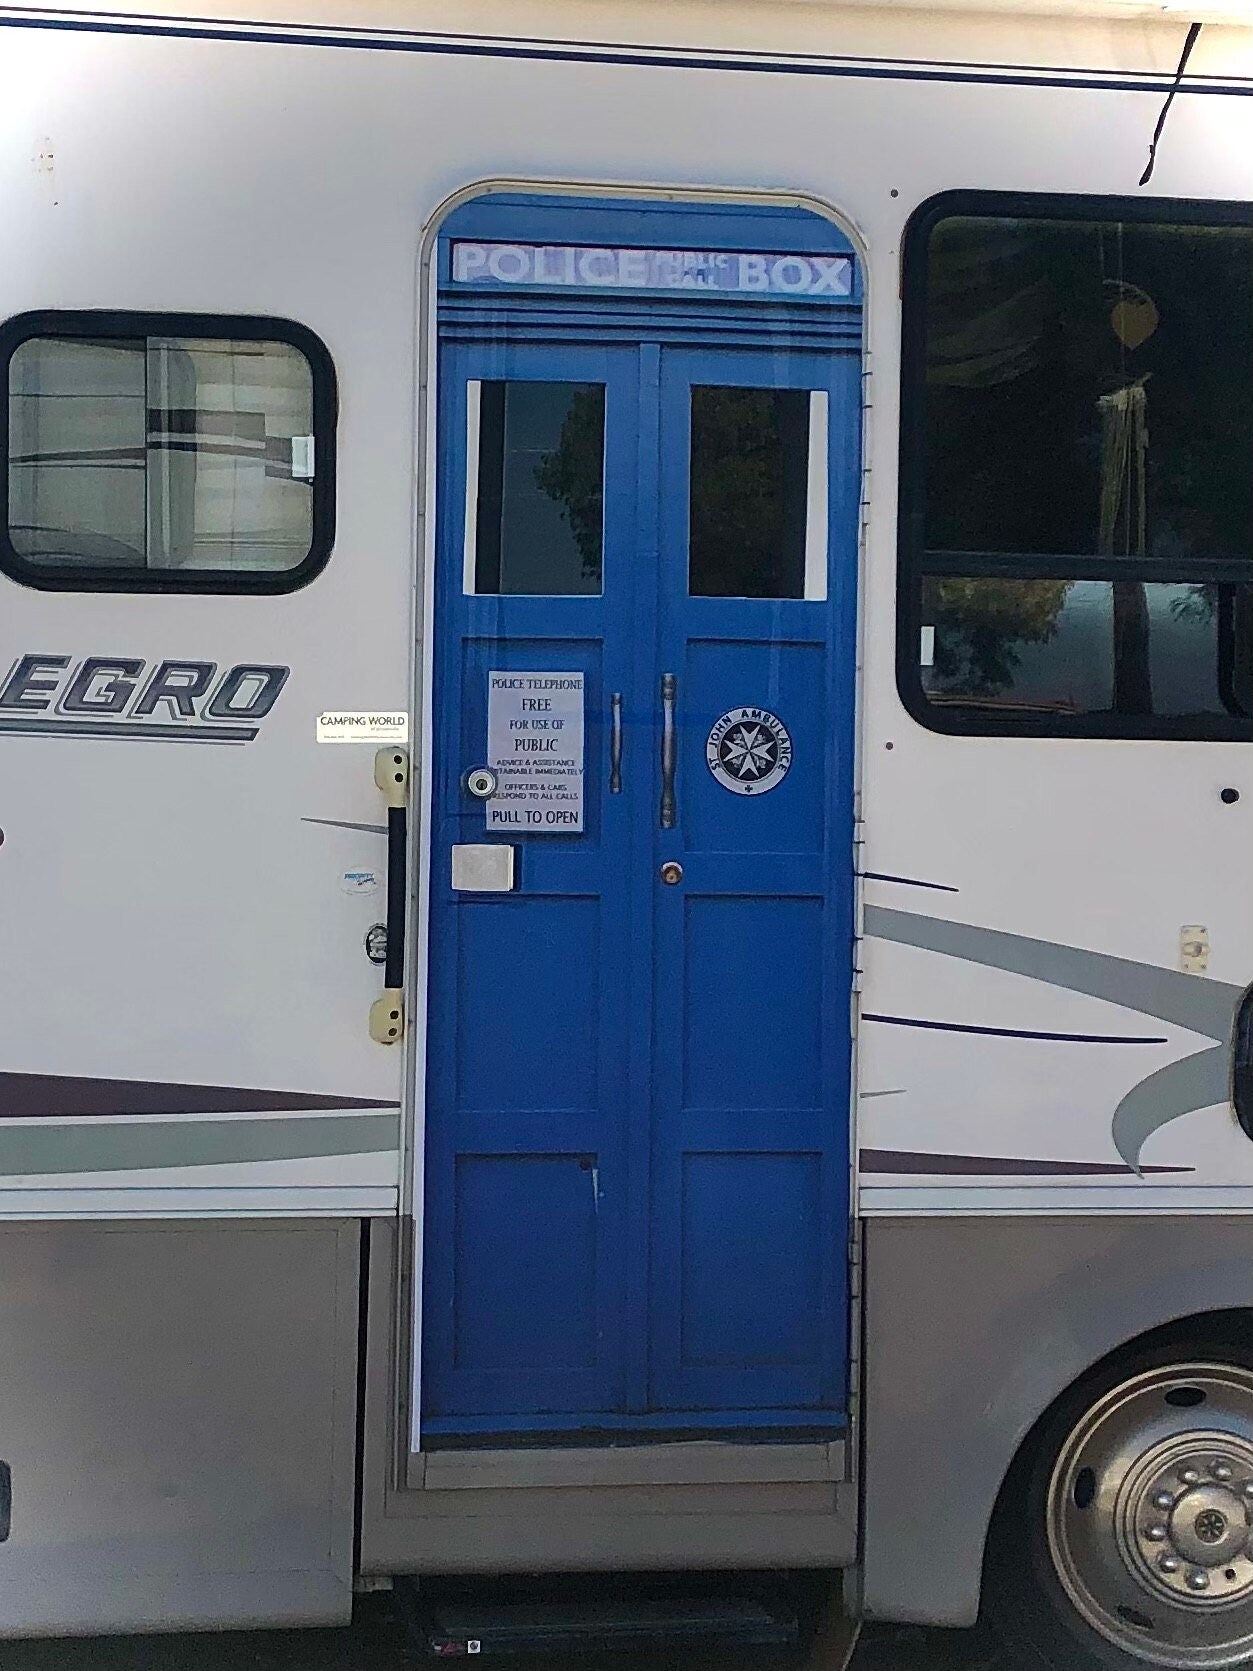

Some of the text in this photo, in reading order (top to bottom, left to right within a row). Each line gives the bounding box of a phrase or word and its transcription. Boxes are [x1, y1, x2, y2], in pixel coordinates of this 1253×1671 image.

[453, 242, 648, 287] POLICE
[738, 254, 850, 295] BOX
[492, 678, 583, 690] POLICE TELEPHONE
[522, 698, 552, 711] FREE
[320, 716, 405, 726] CAMPING WORLD
[509, 719, 566, 730] FOR USE OF
[514, 738, 559, 752] PUBLIC
[709, 709, 791, 773] ST JOHN AMBULANCE
[496, 759, 522, 767] ADVICE
[532, 759, 576, 767] ASSISTANCE
[534, 768, 585, 776] IMMEDIATELY
[504, 783, 568, 792] OFFICERS & CARS
[529, 792, 539, 800] TO
[540, 792, 554, 800] ALL
[492, 810, 579, 824] PULL TO OPEN
